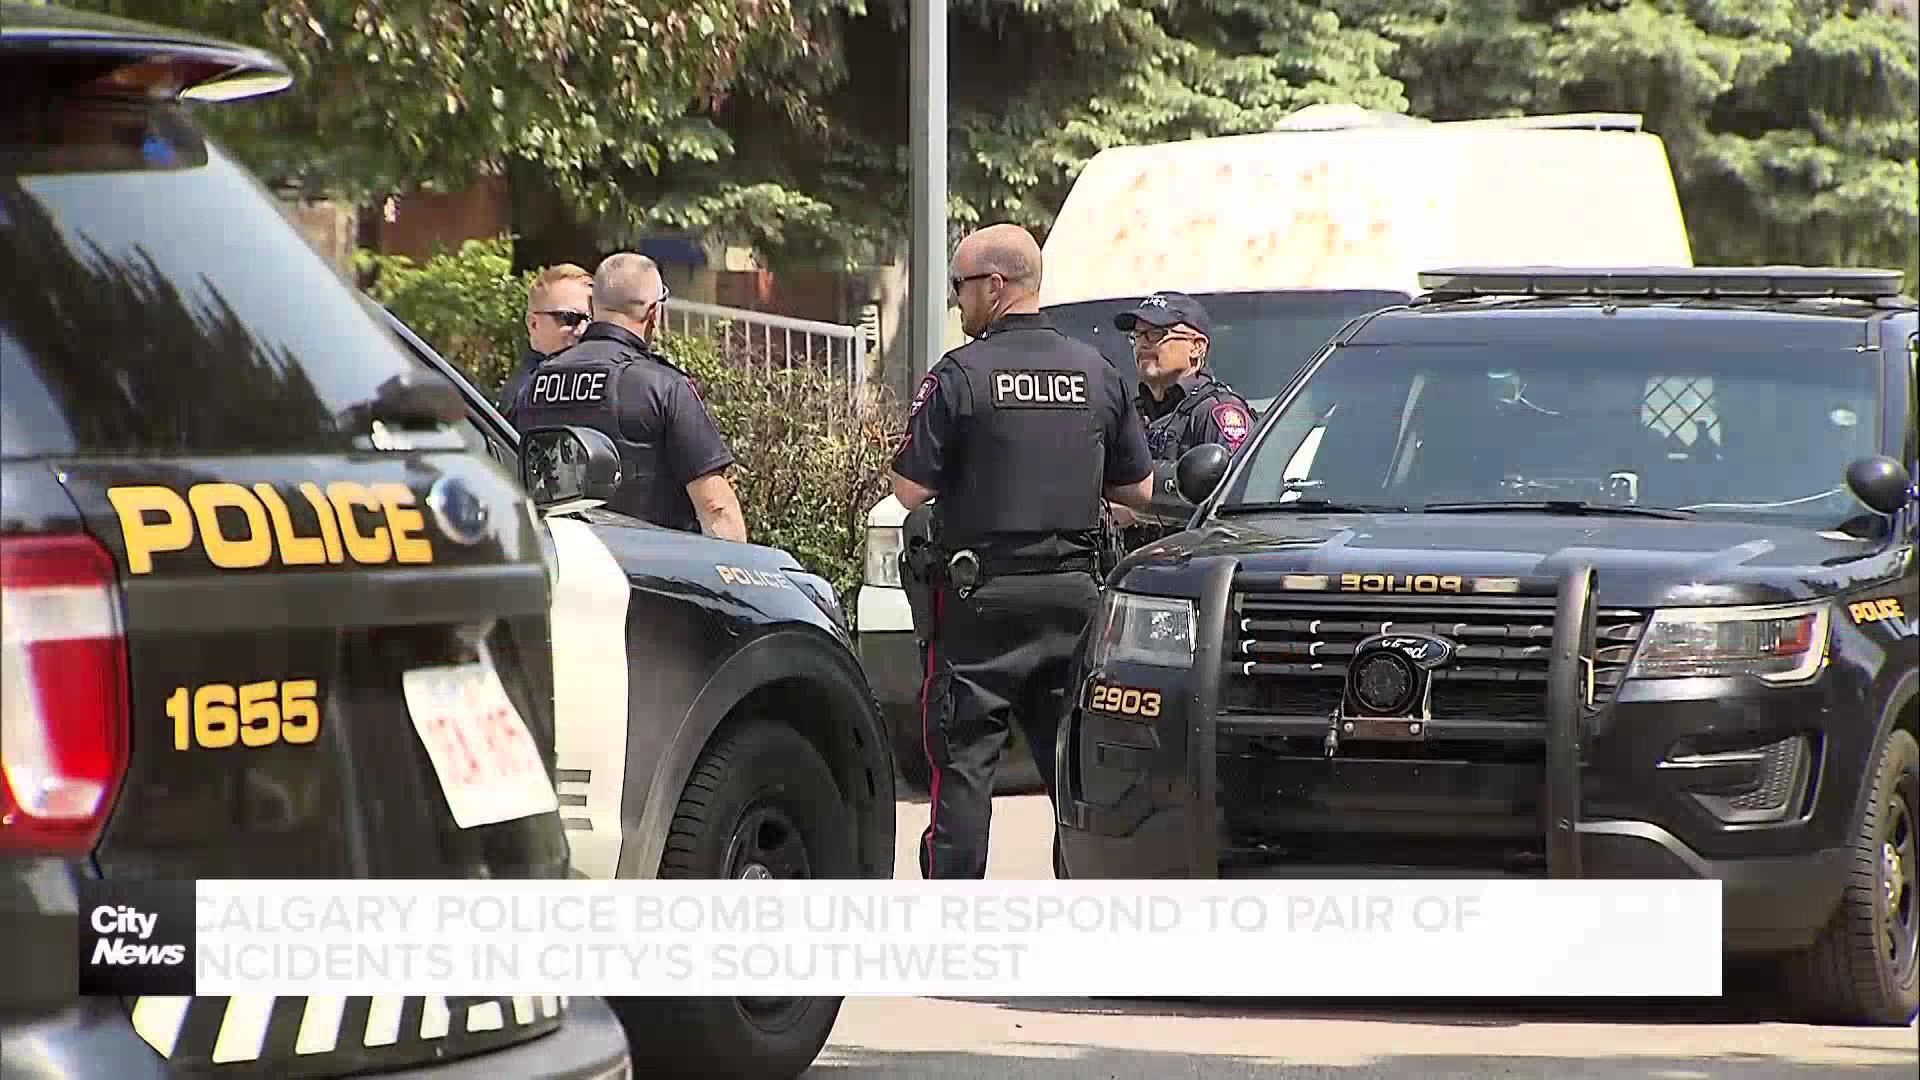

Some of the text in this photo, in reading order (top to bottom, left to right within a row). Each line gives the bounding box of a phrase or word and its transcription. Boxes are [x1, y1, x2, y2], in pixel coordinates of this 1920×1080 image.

[533, 373, 607, 404] POLICE
[996, 373, 1087, 403] POLICE
[107, 483, 433, 574] POLICE
[715, 564, 792, 589] POLICE
[1848, 598, 1905, 624] POLICE
[165, 679, 320, 752] 1655
[1092, 685, 1162, 717] 2903
